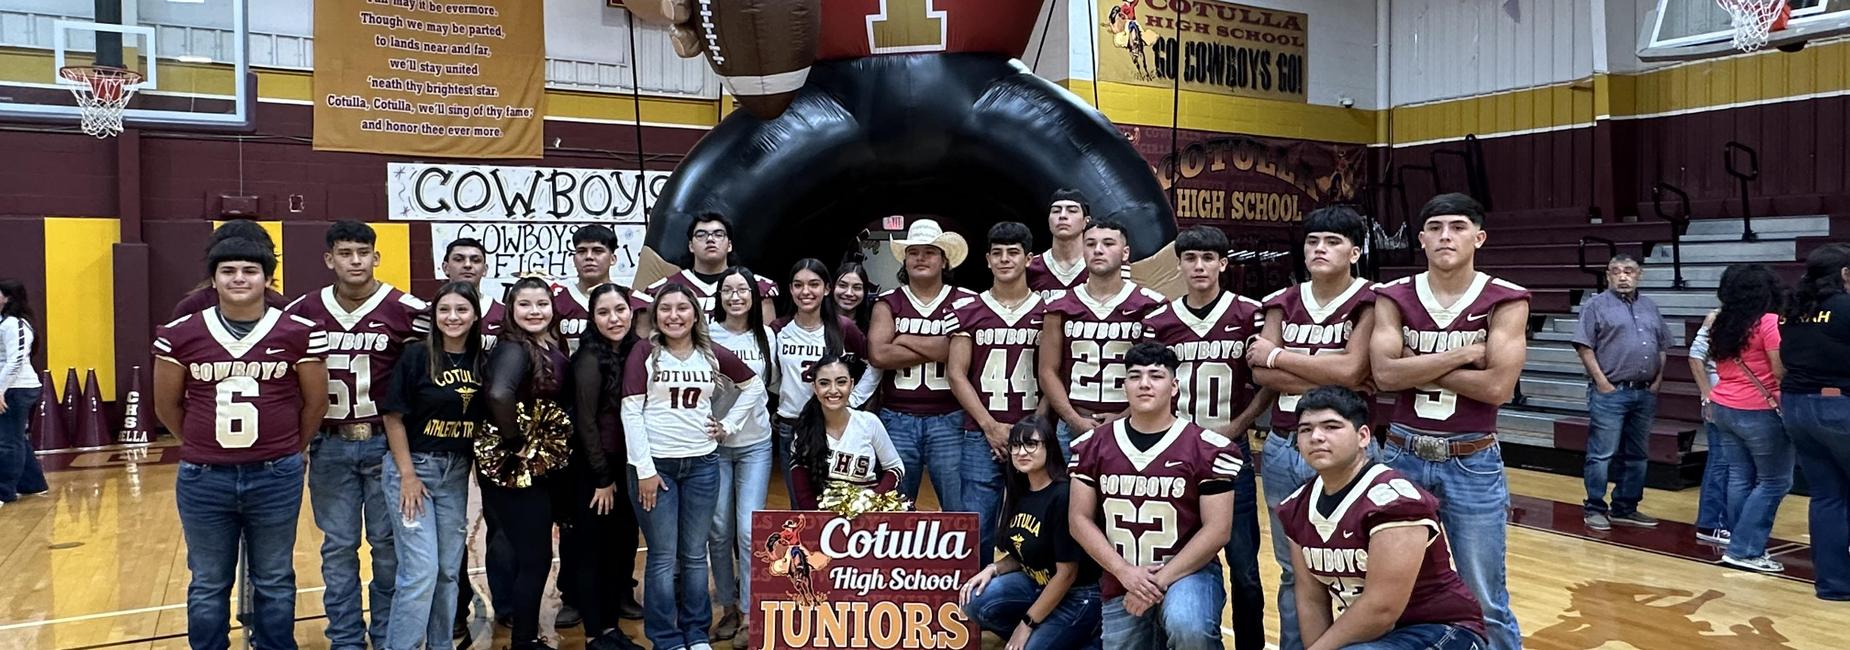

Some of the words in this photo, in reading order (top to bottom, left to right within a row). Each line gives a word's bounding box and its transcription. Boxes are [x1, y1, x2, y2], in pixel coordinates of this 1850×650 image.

[419, 0, 426, 10] it
[429, 2, 442, 13] be
[446, 5, 498, 16] evermore.
[1145, 0, 1304, 31] COTULLA
[361, 12, 403, 29] Though
[407, 20, 422, 30] we
[427, 23, 449, 35] may
[452, 23, 465, 34] be
[469, 25, 505, 38] parted,
[1145, 14, 1210, 35] HIGH
[1216, 25, 1304, 48] SCHOOL
[375, 35, 387, 46] to
[390, 37, 420, 51] lands
[424, 43, 447, 54] near
[451, 43, 471, 55] and
[474, 44, 491, 56] far,
[390, 58, 416, 71] we'll
[420, 62, 442, 76] stay
[446, 63, 479, 75] united
[1152, 36, 1177, 80] GO
[1184, 40, 1272, 91] COWBOYS
[1276, 52, 1303, 95] GO!
[406, 80, 423, 94] thy
[426, 83, 473, 97] brightest
[476, 86, 498, 96] star.
[327, 95, 370, 110] Cotulla,
[373, 98, 414, 113] Cotulla,
[418, 102, 445, 114] we'll
[448, 104, 470, 118] sing
[473, 106, 484, 117] of
[486, 105, 503, 119] thy
[361, 119, 382, 131] and
[386, 120, 418, 133] honor
[421, 123, 444, 135] thee
[448, 126, 471, 136] ever
[474, 126, 503, 137] more.
[1176, 188, 1226, 220] HIGH
[1231, 190, 1302, 222] SCHOOL
[494, 250, 577, 278] FIGH
[327, 331, 390, 352] WBOYS
[1064, 320, 1143, 339] COWBOYS
[1281, 320, 1353, 344] OWBOYS
[782, 343, 826, 356] COTUL
[1166, 340, 1245, 361] OWBOYS
[189, 361, 289, 382] COWBOYS
[435, 368, 482, 387] COTUL
[980, 348, 1039, 411] 44
[1069, 340, 1135, 403] 22
[324, 353, 379, 420] 51
[669, 387, 702, 409] 10
[1175, 361, 1233, 430] 10
[215, 374, 260, 449] 6
[826, 448, 870, 478] HS
[1100, 474, 1187, 498] COWBOYS
[820, 517, 972, 560] Cotulla
[1009, 513, 1041, 538] OTULLA
[1103, 497, 1179, 567] 62
[1302, 546, 1369, 573] OWBOYS
[829, 567, 887, 596] High
[889, 567, 963, 592] School
[759, 601, 970, 650] JUNIORS
